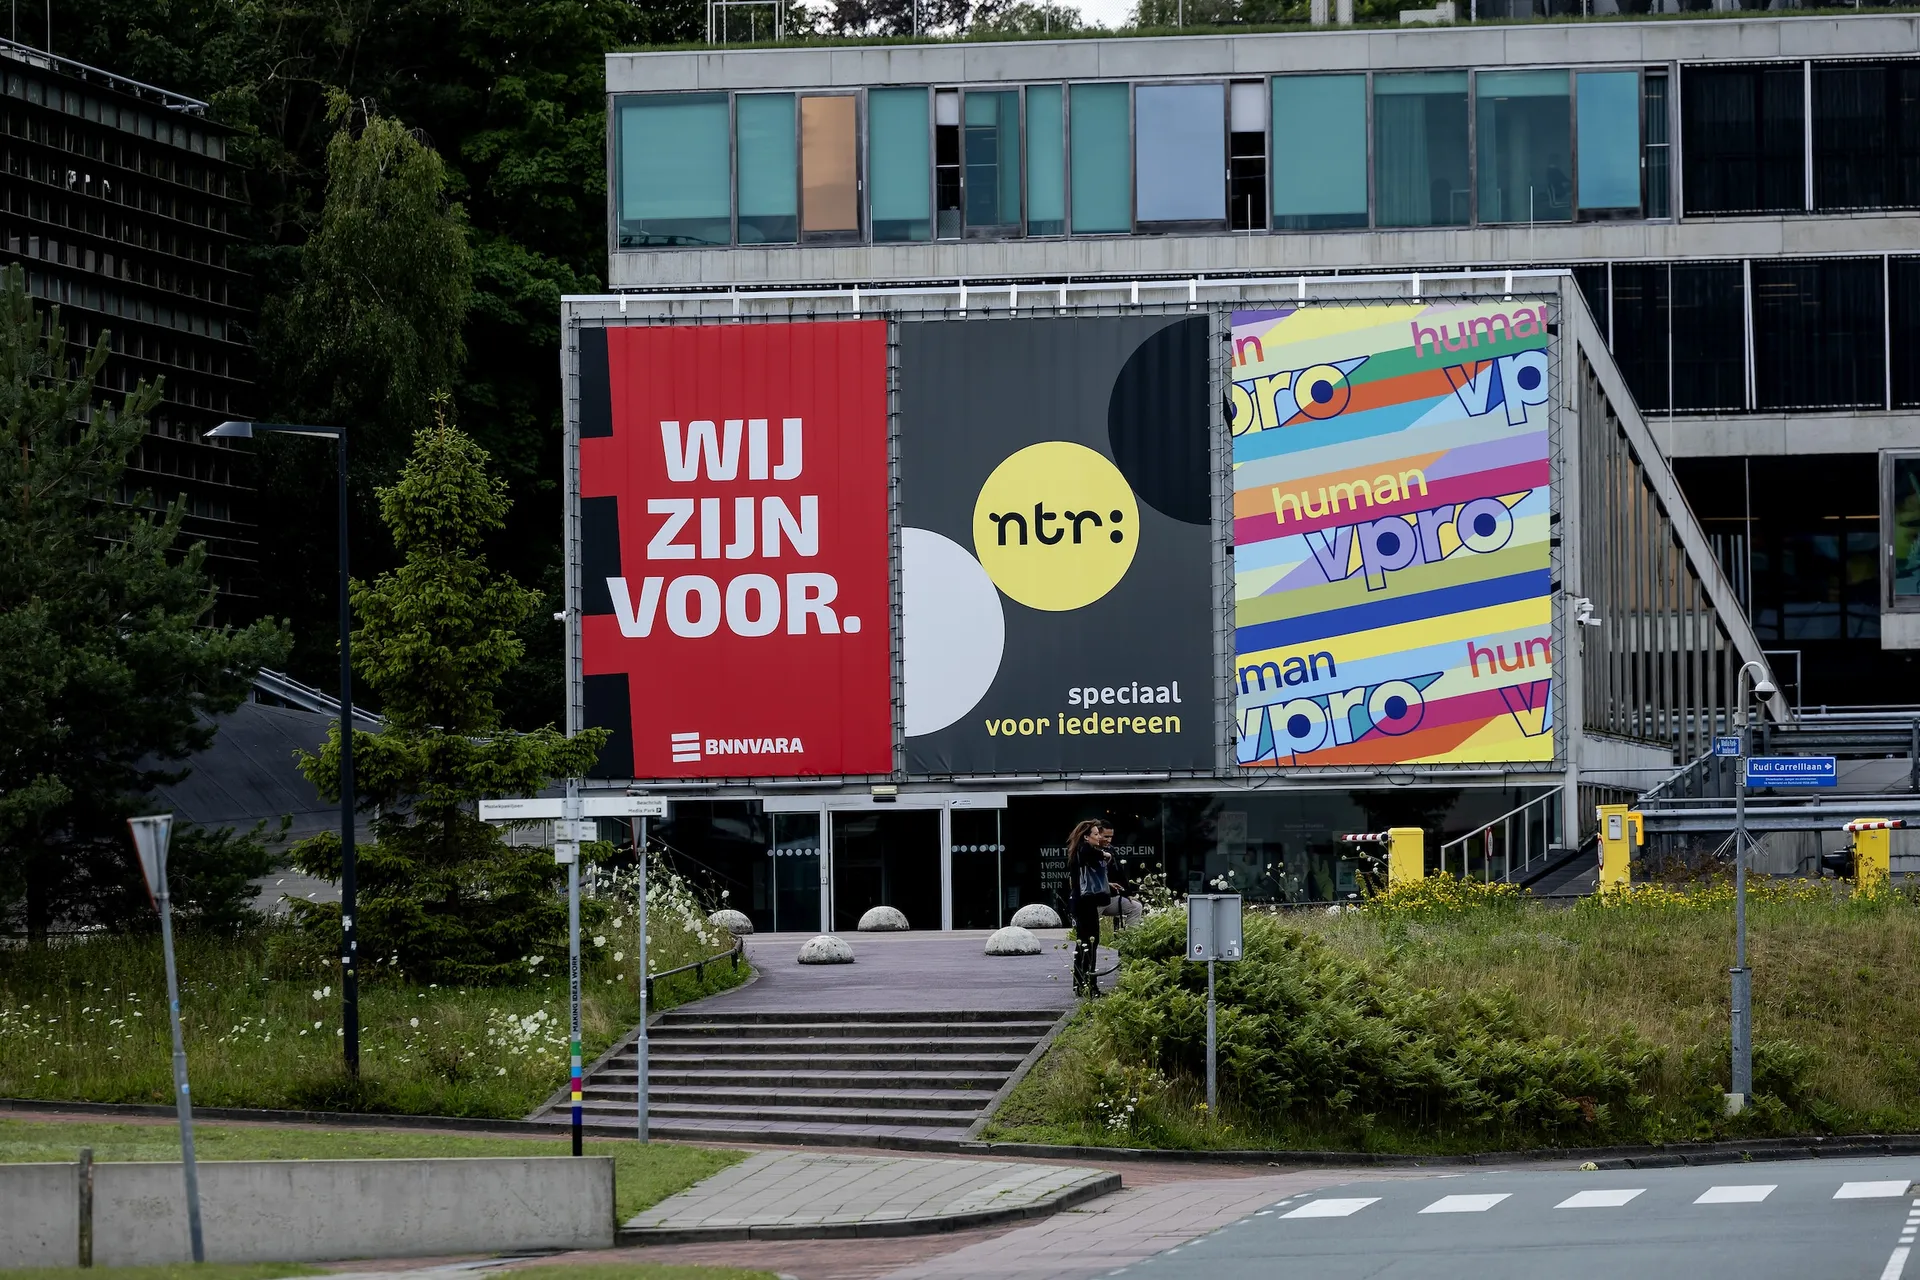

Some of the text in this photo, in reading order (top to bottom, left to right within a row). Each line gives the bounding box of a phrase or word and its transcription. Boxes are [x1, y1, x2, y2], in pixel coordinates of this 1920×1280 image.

[660, 418, 803, 482] WIJ
[1272, 468, 1428, 525] human
[647, 495, 819, 560] ZIJN
[989, 501, 1124, 546] ntr:
[1303, 489, 1533, 592] vpro
[606, 572, 862, 638] VOOR.
[1235, 651, 1337, 696] man
[1068, 680, 1182, 709] speciaal
[985, 711, 1181, 737] voor iedereen
[705, 737, 804, 755] BNNVARA
[1753, 762, 1822, 771] Rudi Carrelllaan
[1040, 847, 1060, 857] WIM
[1045, 861, 1066, 869] VPRO
[1046, 881, 1063, 889] NTR
